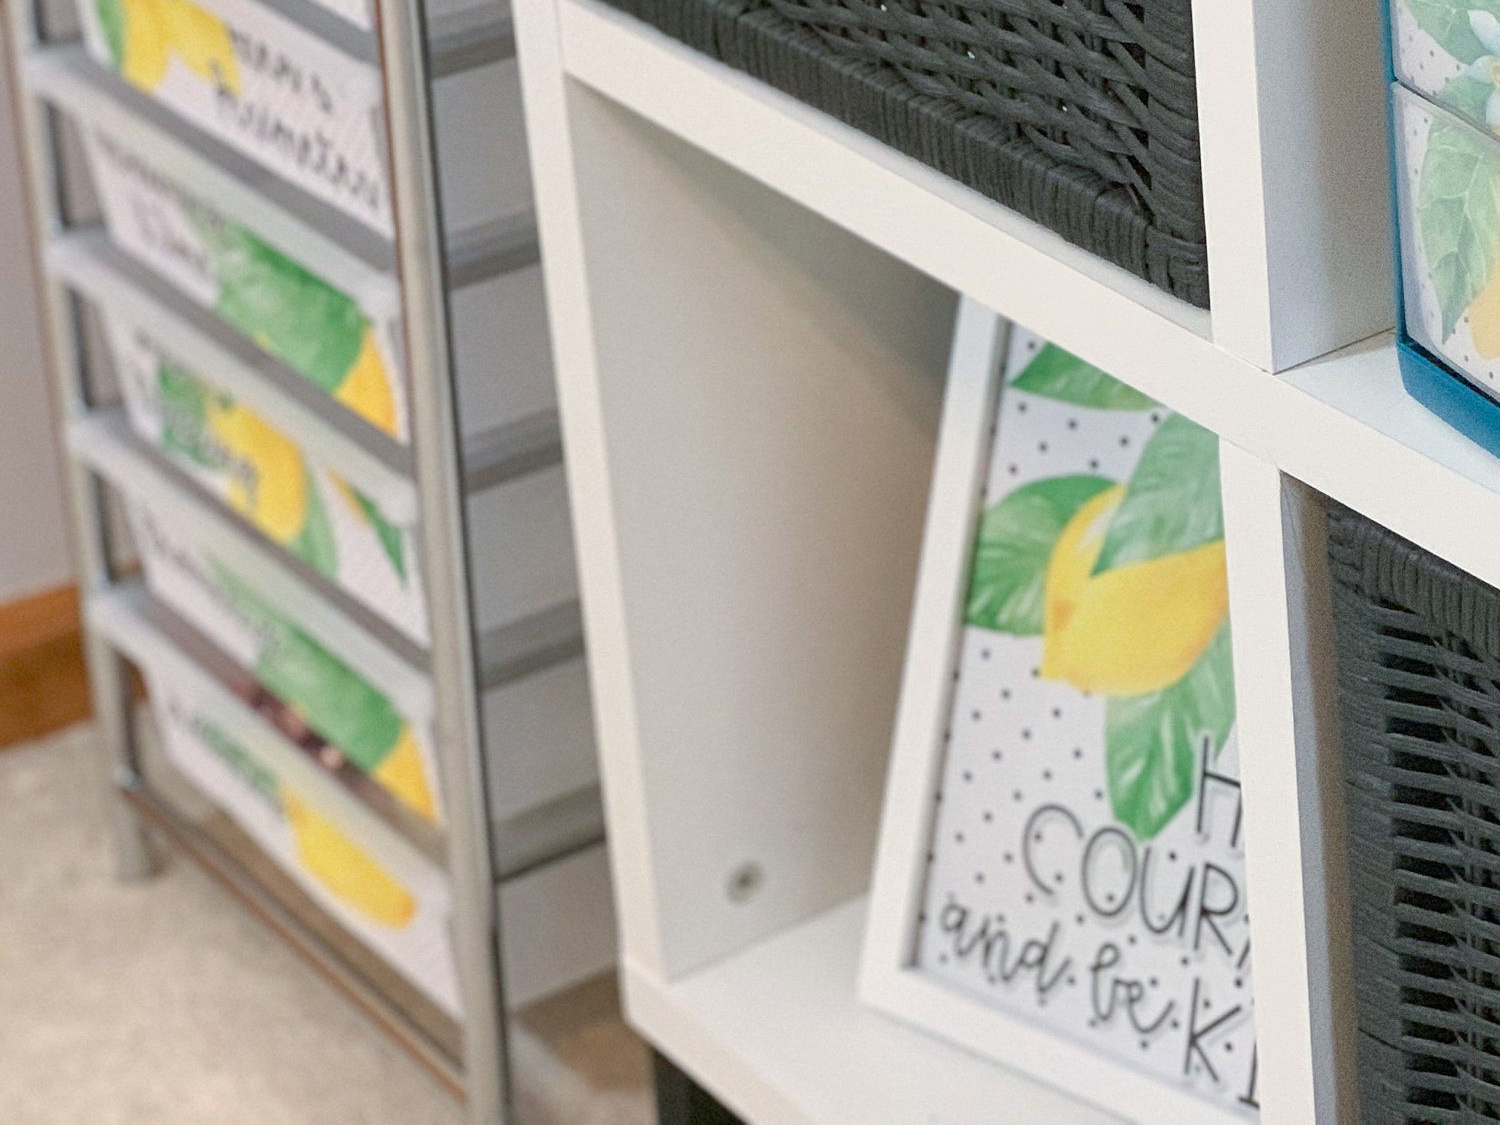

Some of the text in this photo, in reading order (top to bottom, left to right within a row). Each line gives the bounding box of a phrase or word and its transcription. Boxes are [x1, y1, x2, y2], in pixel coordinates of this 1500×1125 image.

[1022, 803, 1251, 969] COUR
[940, 901, 1072, 997] and
[1090, 942, 1174, 1034] be
